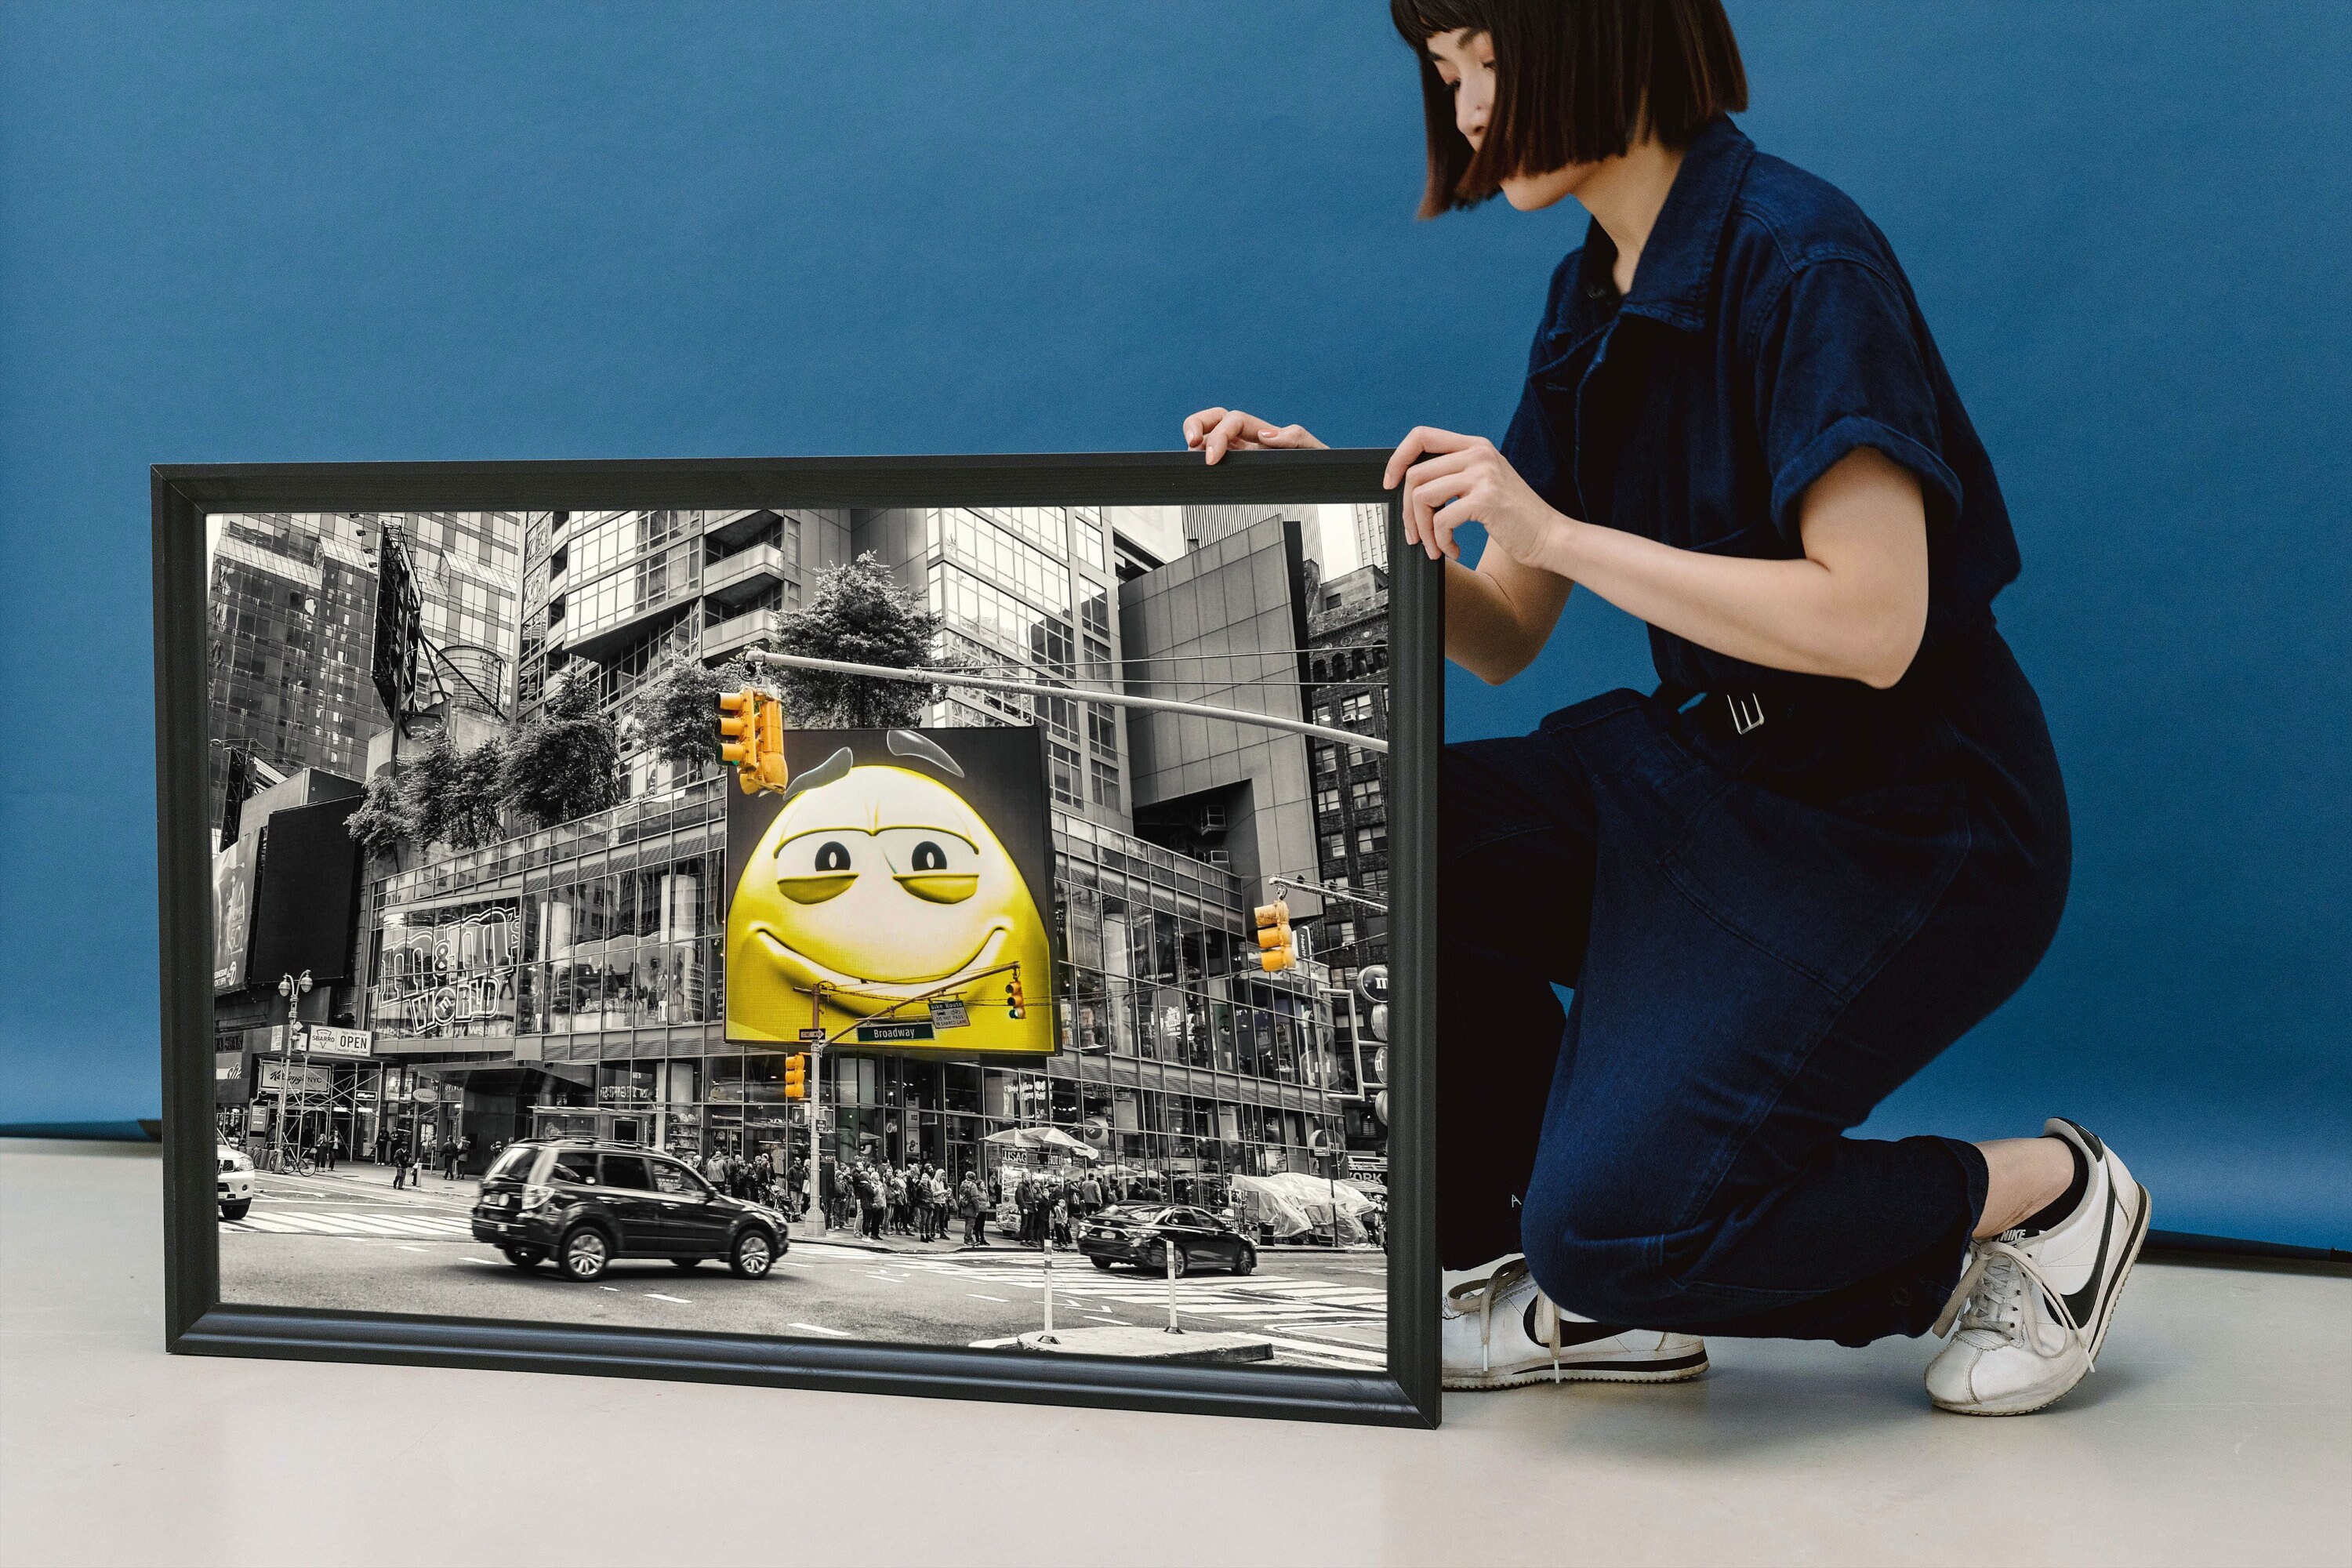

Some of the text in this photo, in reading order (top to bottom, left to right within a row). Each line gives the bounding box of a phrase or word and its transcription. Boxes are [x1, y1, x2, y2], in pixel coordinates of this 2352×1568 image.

[873, 1027, 915, 1039] Broadway
[339, 1035, 367, 1049] OPEN
[2000, 1229, 2027, 1242] NIKE
